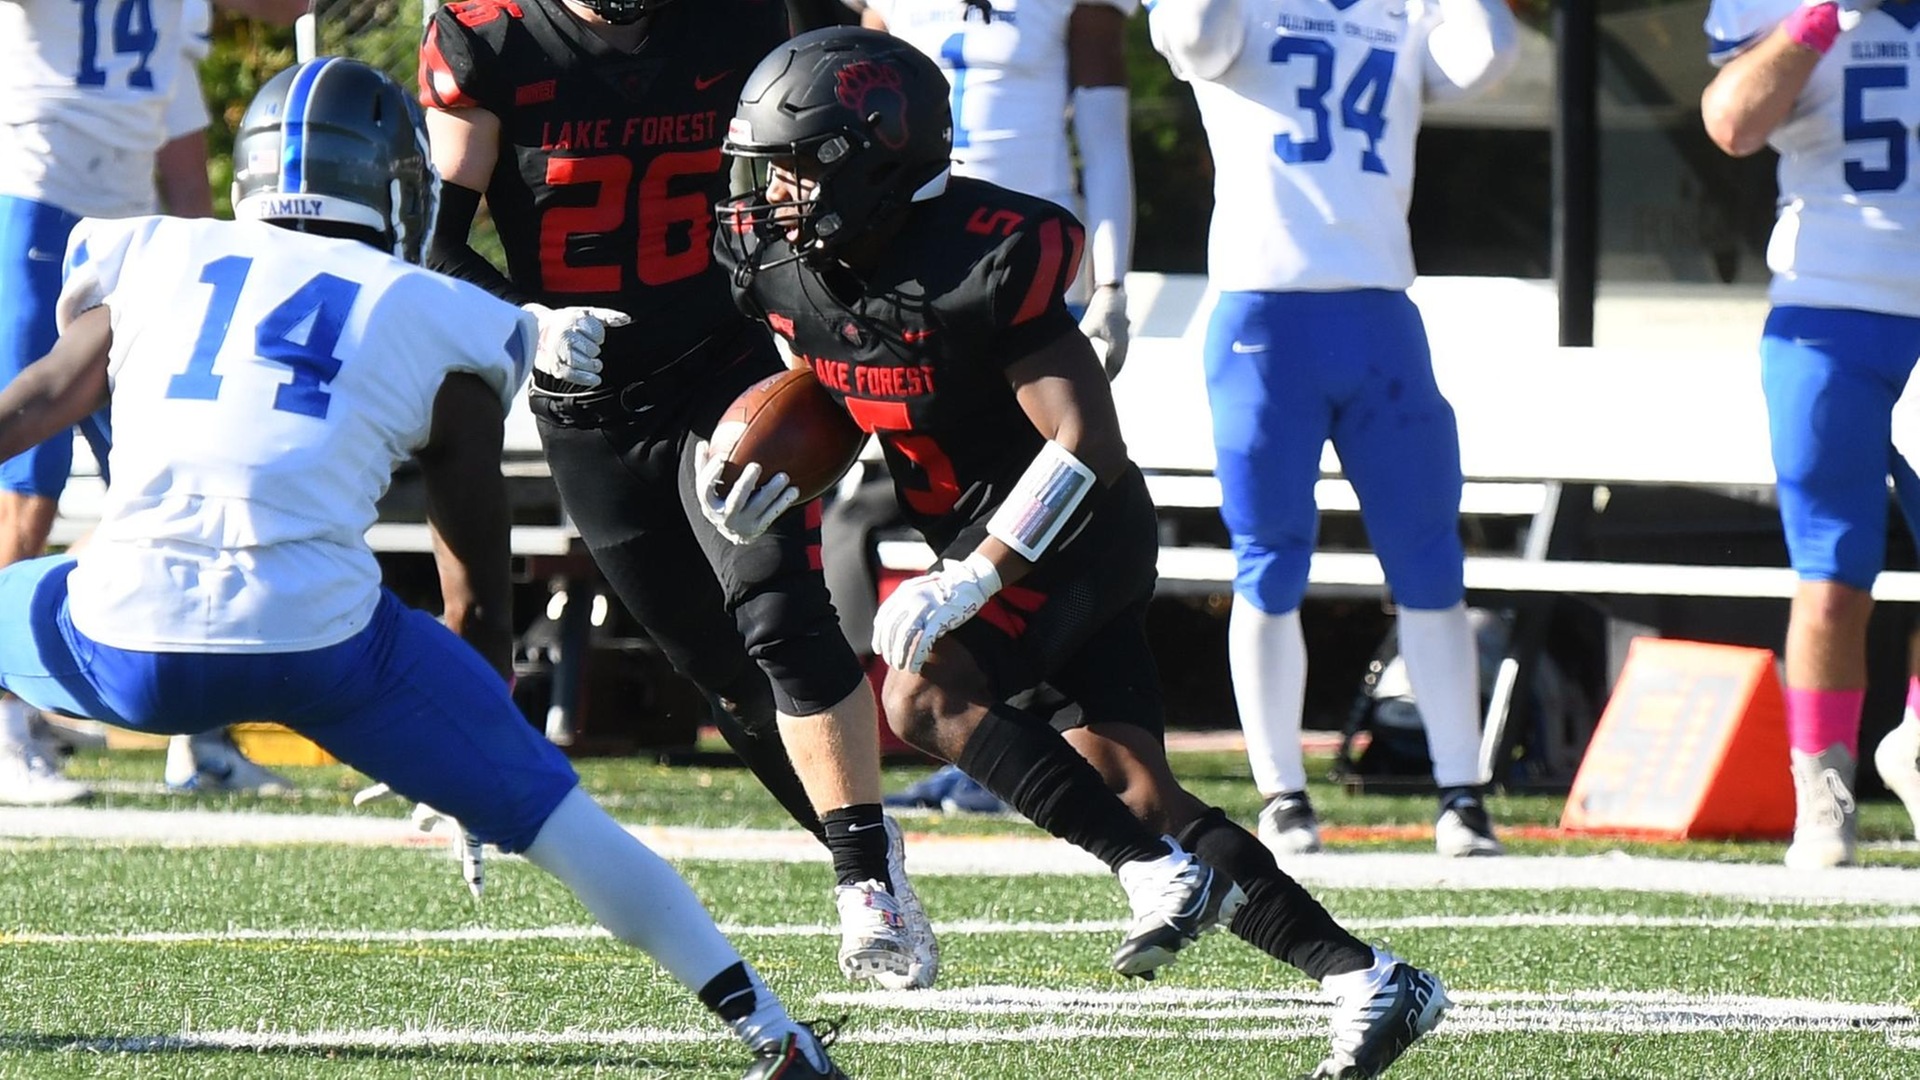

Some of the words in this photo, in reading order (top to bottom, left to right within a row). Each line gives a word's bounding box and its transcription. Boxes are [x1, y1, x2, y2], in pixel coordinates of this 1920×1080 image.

[70, 0, 157, 89] 14
[941, 33, 970, 148] 1
[541, 118, 612, 151] LAKE
[621, 110, 717, 147] FOREST
[1270, 36, 1396, 174] 34
[1844, 66, 1920, 191] 5
[260, 200, 323, 216] FAMILY
[539, 147, 722, 293] 26
[965, 206, 1025, 236] 5
[165, 254, 361, 420] 14
[855, 365, 935, 396] FOREST
[844, 396, 961, 515] 5
